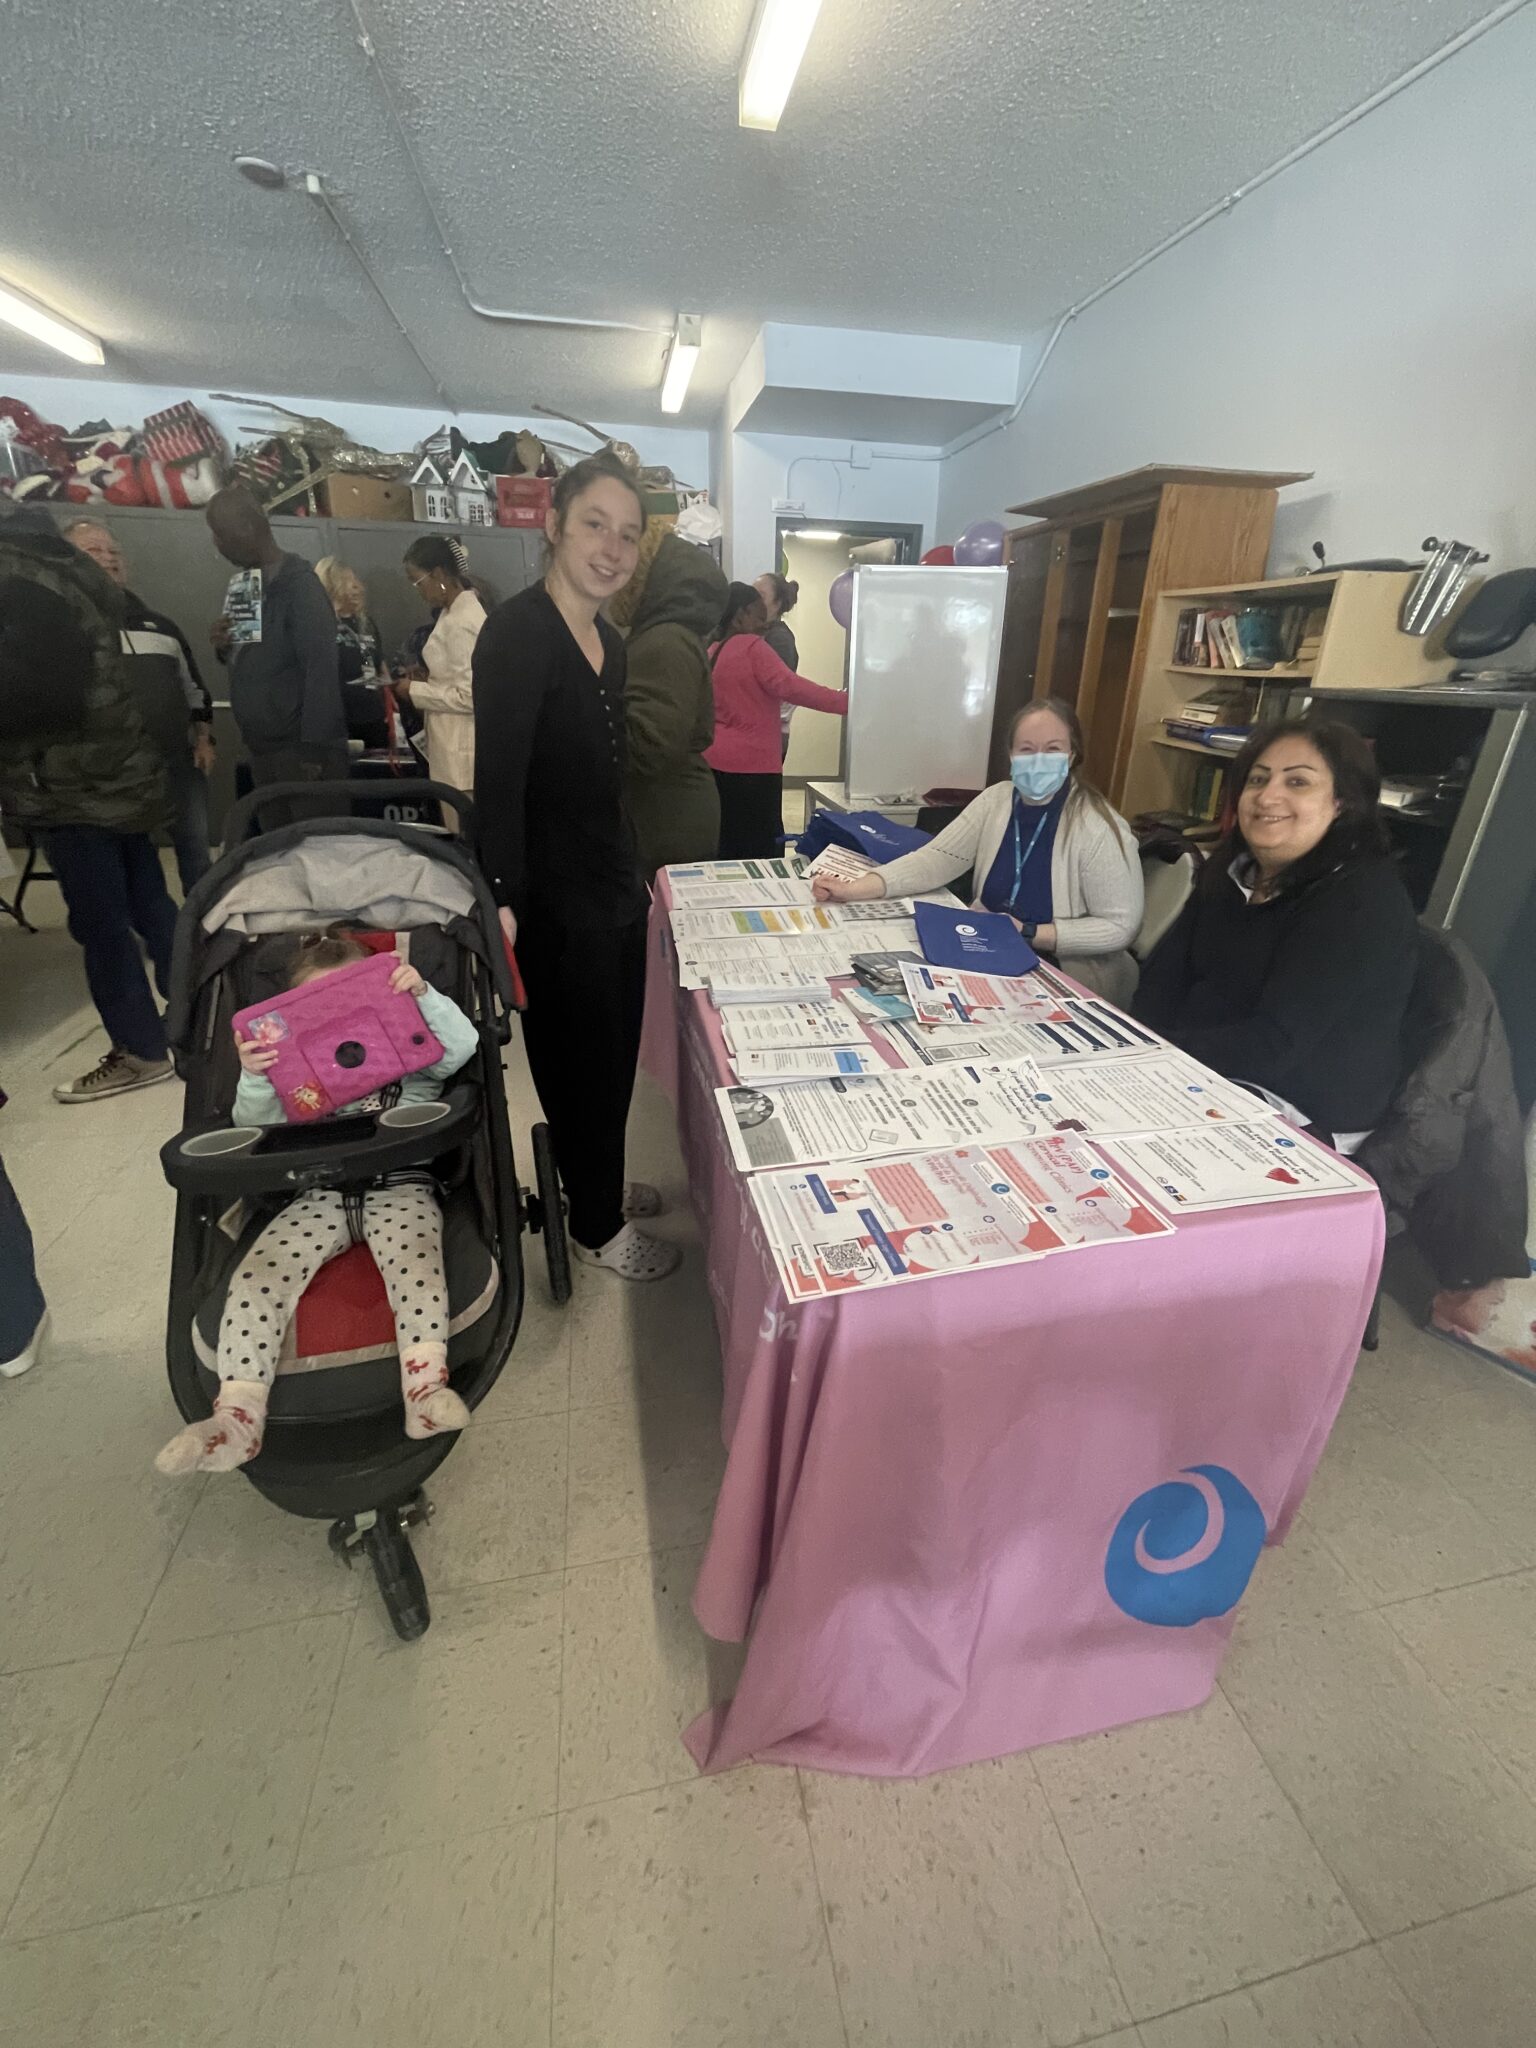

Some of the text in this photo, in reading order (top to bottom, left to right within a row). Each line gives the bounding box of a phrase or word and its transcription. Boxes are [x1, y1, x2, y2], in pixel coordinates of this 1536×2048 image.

[1035, 1140, 1067, 1168] Cervical
[1055, 1153, 1086, 1174] (PAP)
[1049, 1170, 1074, 1194] Clinics
